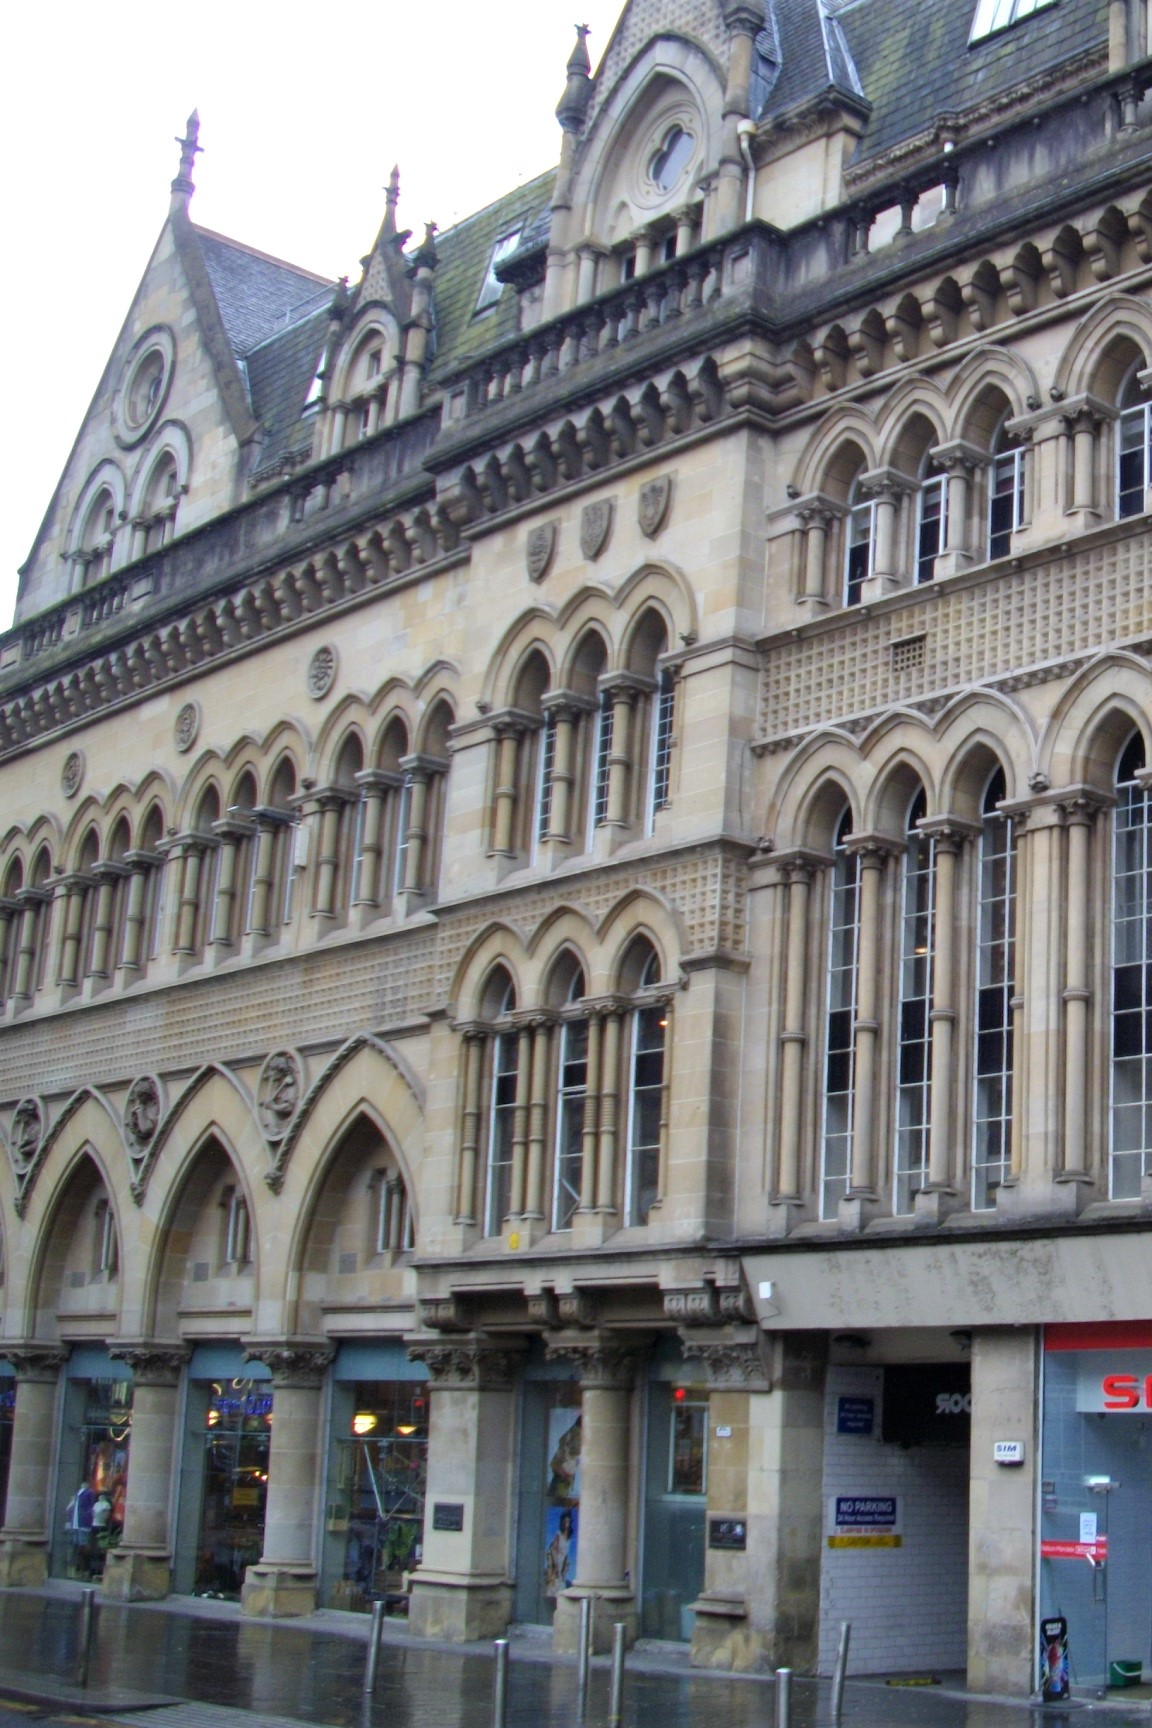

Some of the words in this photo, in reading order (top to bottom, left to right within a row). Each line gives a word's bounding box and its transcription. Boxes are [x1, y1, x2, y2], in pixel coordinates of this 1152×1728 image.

[996, 1444, 1017, 1453] SIM
[840, 1501, 854, 1513] NO
[855, 1500, 893, 1513] PARKING
